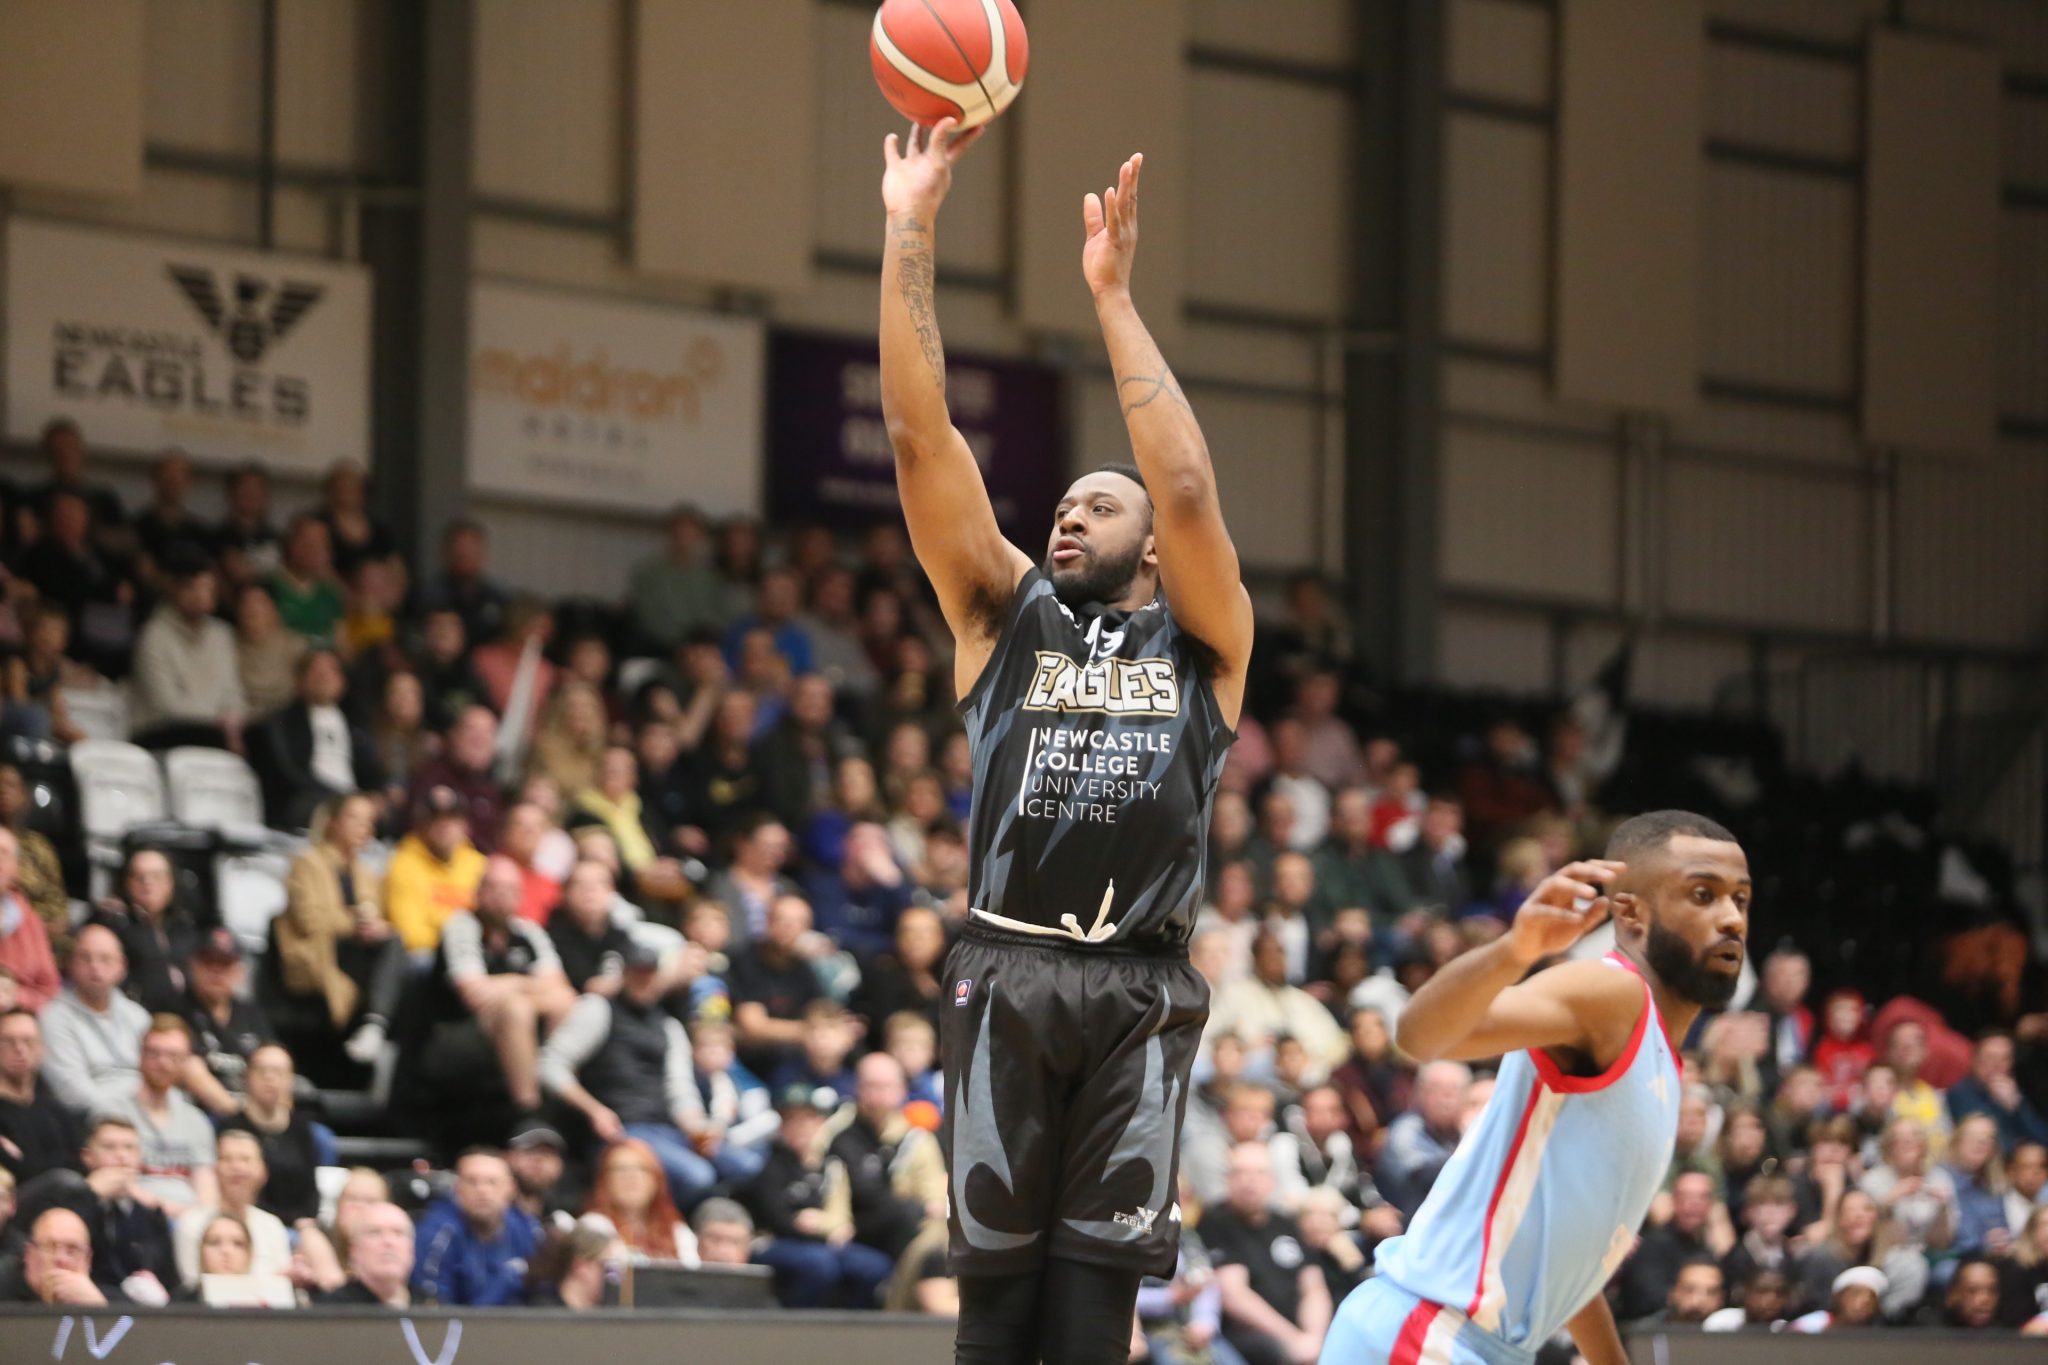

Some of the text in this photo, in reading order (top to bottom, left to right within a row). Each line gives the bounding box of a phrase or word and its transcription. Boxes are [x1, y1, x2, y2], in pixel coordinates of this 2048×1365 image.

[53, 348, 310, 426] EAGLES
[1083, 616, 1125, 660] 13
[1025, 652, 1179, 716] EAGLES
[1038, 727, 1171, 753] NEWCASTLE
[1034, 750, 1139, 775] COLLEGE
[1031, 775, 1162, 800] UNIVERSITY
[1026, 798, 1117, 824] CENTRE
